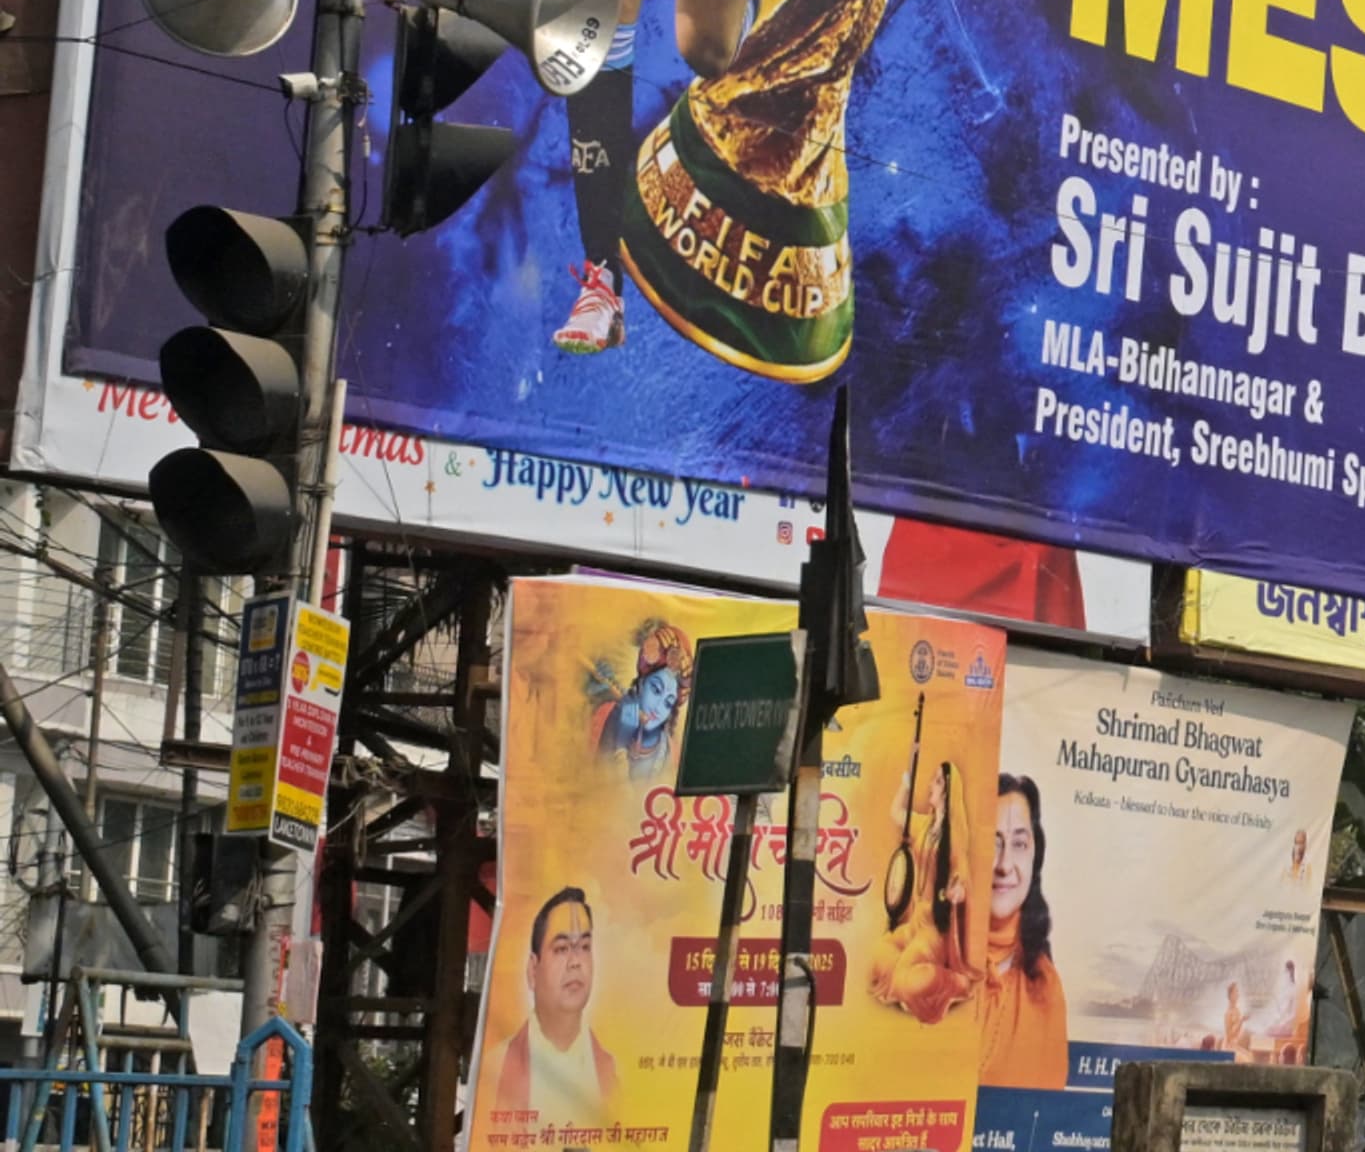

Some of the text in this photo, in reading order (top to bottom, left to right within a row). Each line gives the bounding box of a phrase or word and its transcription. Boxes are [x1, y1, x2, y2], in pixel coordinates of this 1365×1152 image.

[1059, 113, 1203, 195] Presented
[654, 197, 824, 318] WORLD CUP
[1050, 176, 1150, 302] Sri
[1169, 208, 1323, 355] Sujit
[1040, 319, 1325, 425] MLA-Bidhannagar &
[1034, 387, 1181, 467] President,
[1190, 419, 1336, 492] Sreebhumi
[482, 448, 594, 506] Happy
[598, 467, 674, 511] New
[673, 475, 746, 525] Year
[1056, 737, 1292, 803] Mahapuran Gyanrahasya
[1096, 706, 1263, 760] Shrimad Bhagwat
